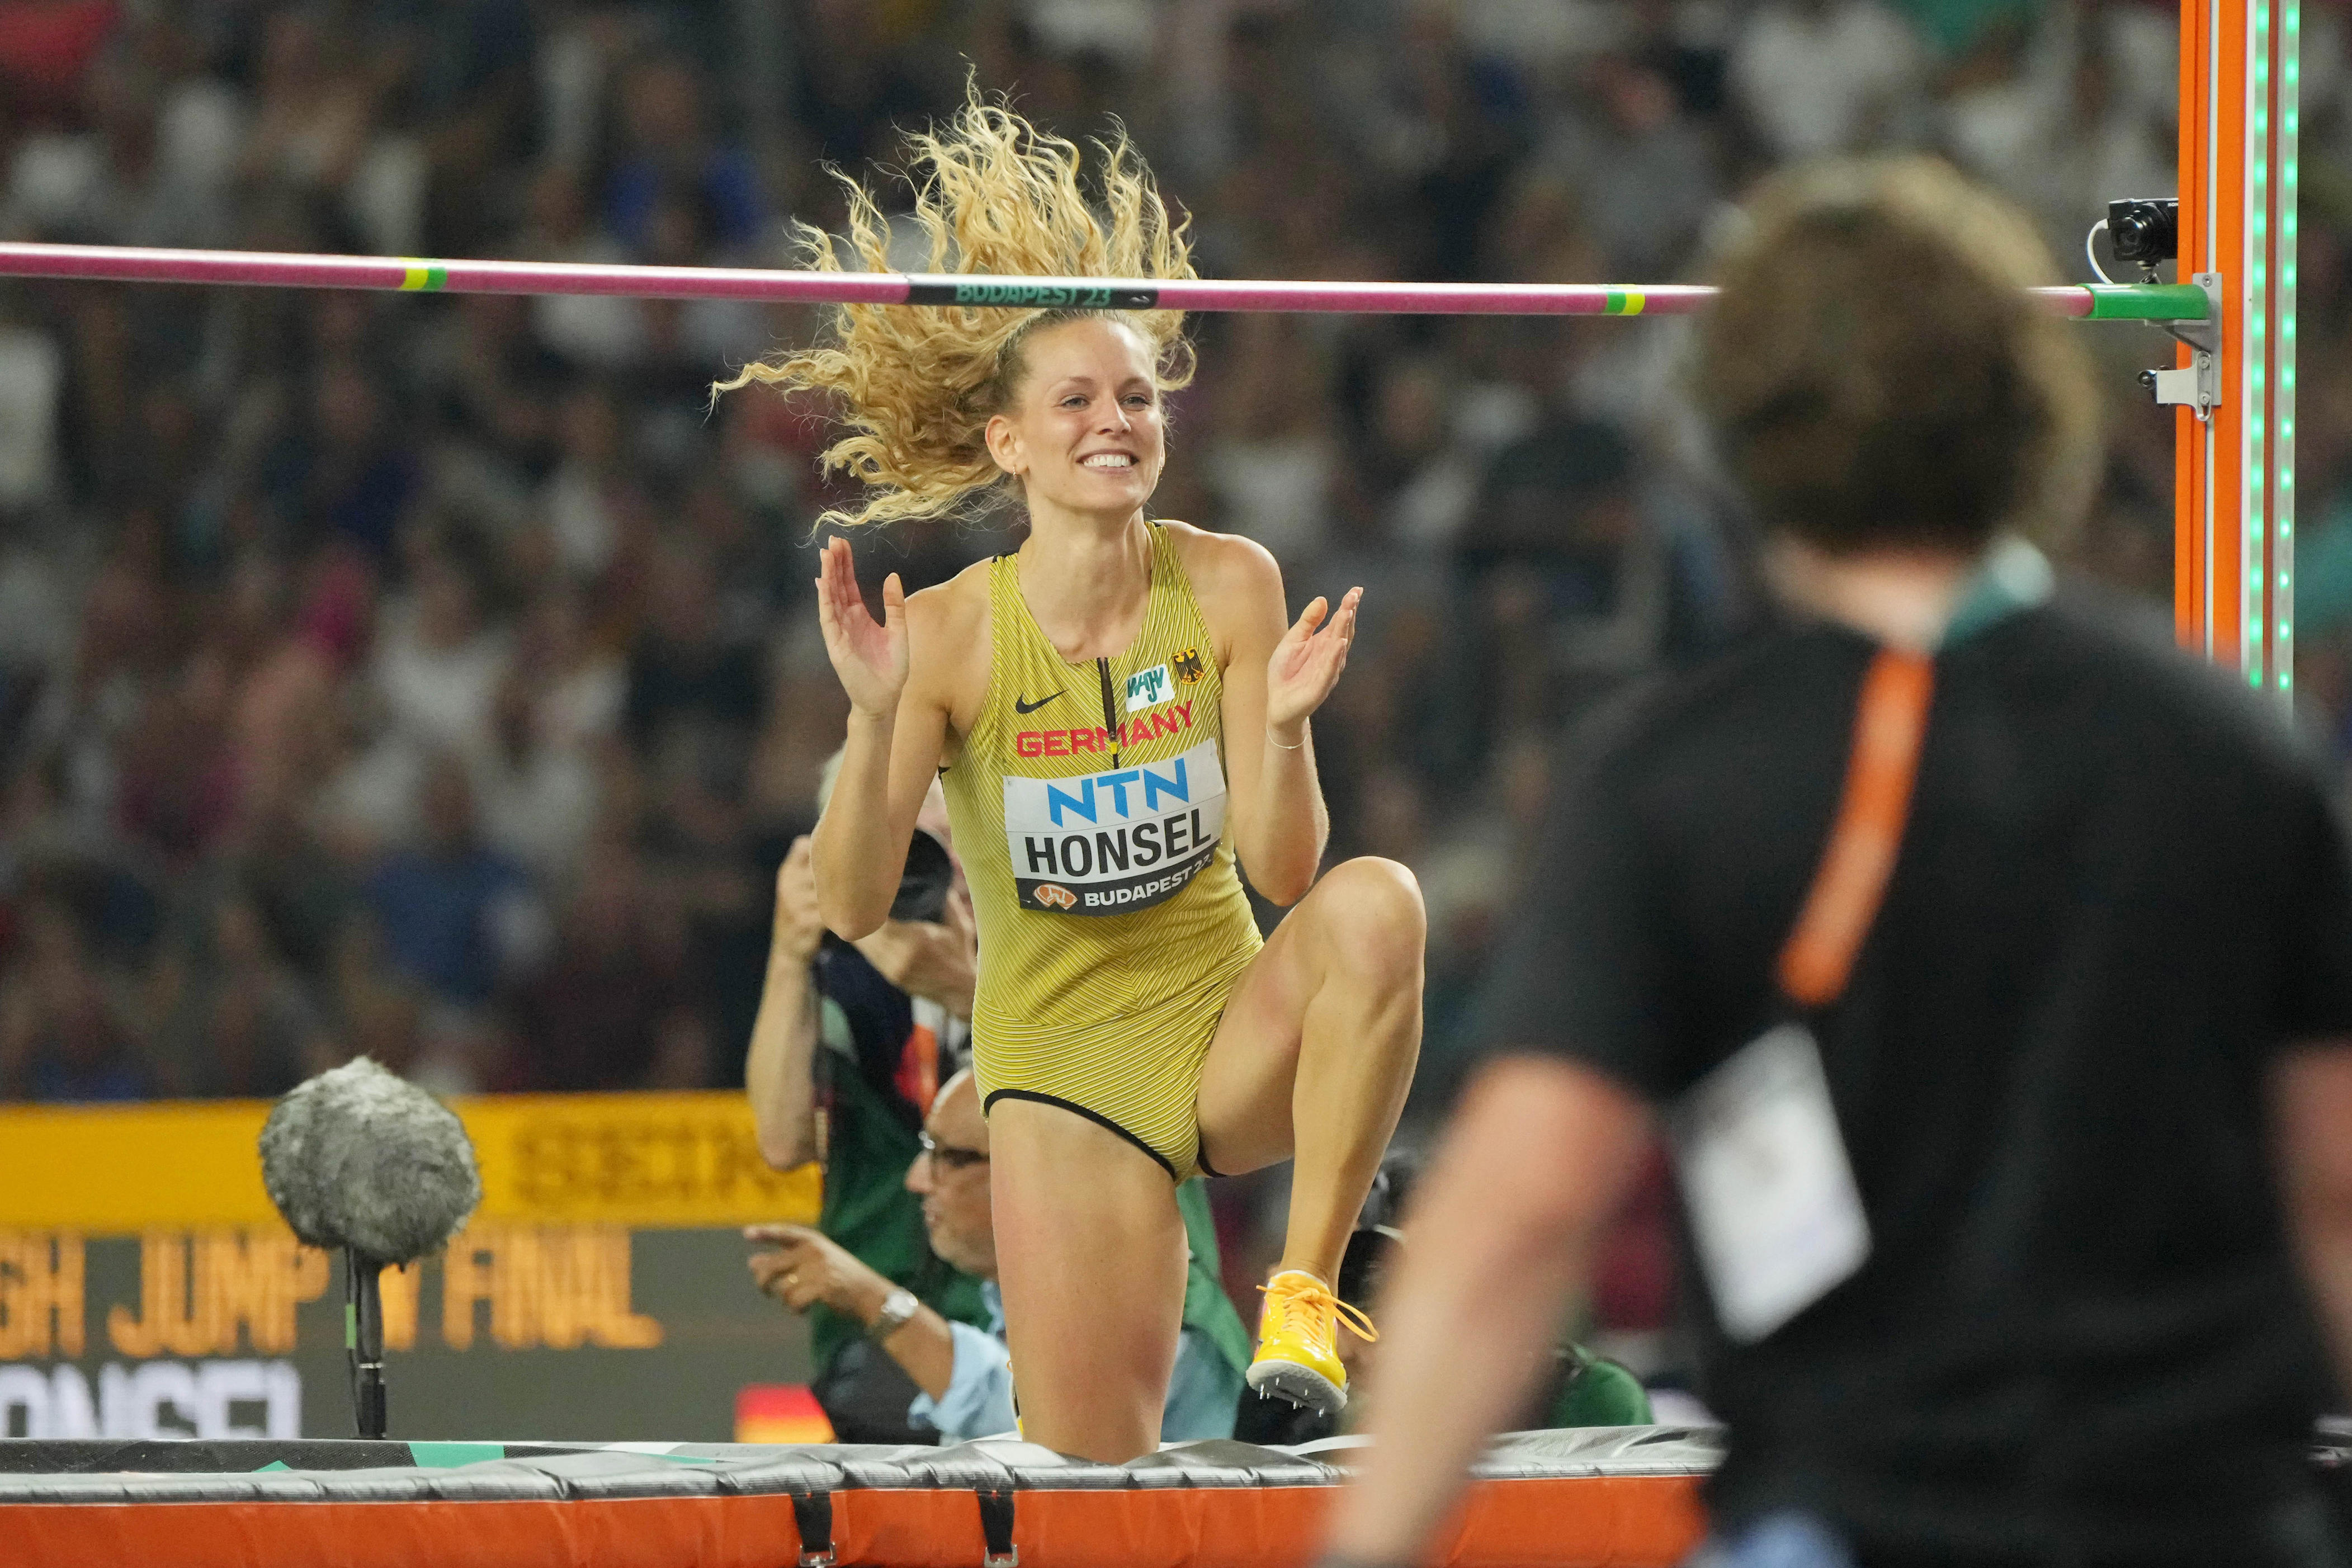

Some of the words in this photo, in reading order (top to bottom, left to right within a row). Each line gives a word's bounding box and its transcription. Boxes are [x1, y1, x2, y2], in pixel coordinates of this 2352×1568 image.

[956, 284, 1077, 305] BUDAPEST
[1016, 700, 1193, 757] GERMANY
[1047, 758, 1189, 828] NTN
[1025, 809, 1211, 877] HONSEL
[1084, 866, 1193, 906] BUDAPEST
